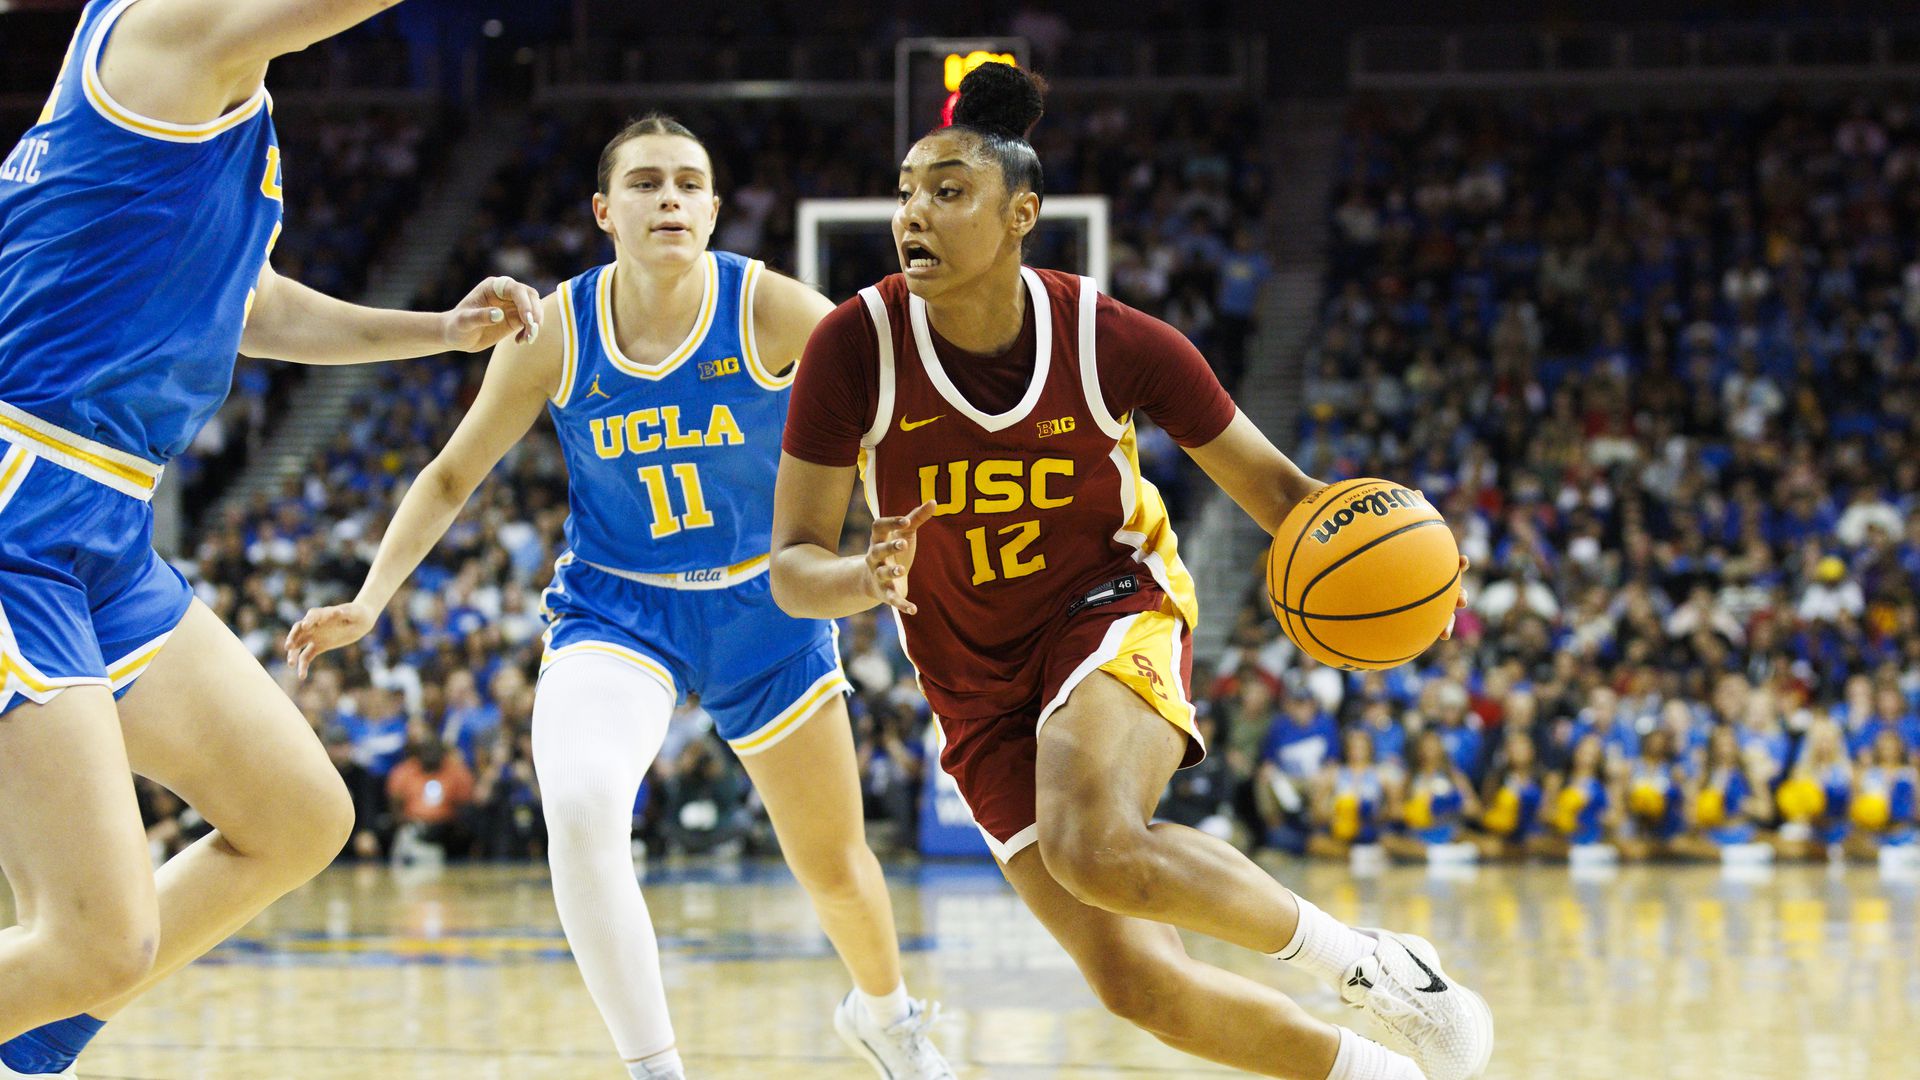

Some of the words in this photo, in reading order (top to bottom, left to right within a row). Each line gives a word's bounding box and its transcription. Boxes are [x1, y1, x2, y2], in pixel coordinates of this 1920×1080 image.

[0, 131, 50, 184] LIĆ
[589, 404, 745, 459] UCLA
[637, 462, 714, 540] 11
[918, 457, 1075, 517] USC
[1310, 487, 1420, 544] Wilson
[965, 519, 1047, 586] 12
[1118, 579, 1132, 590] 46
